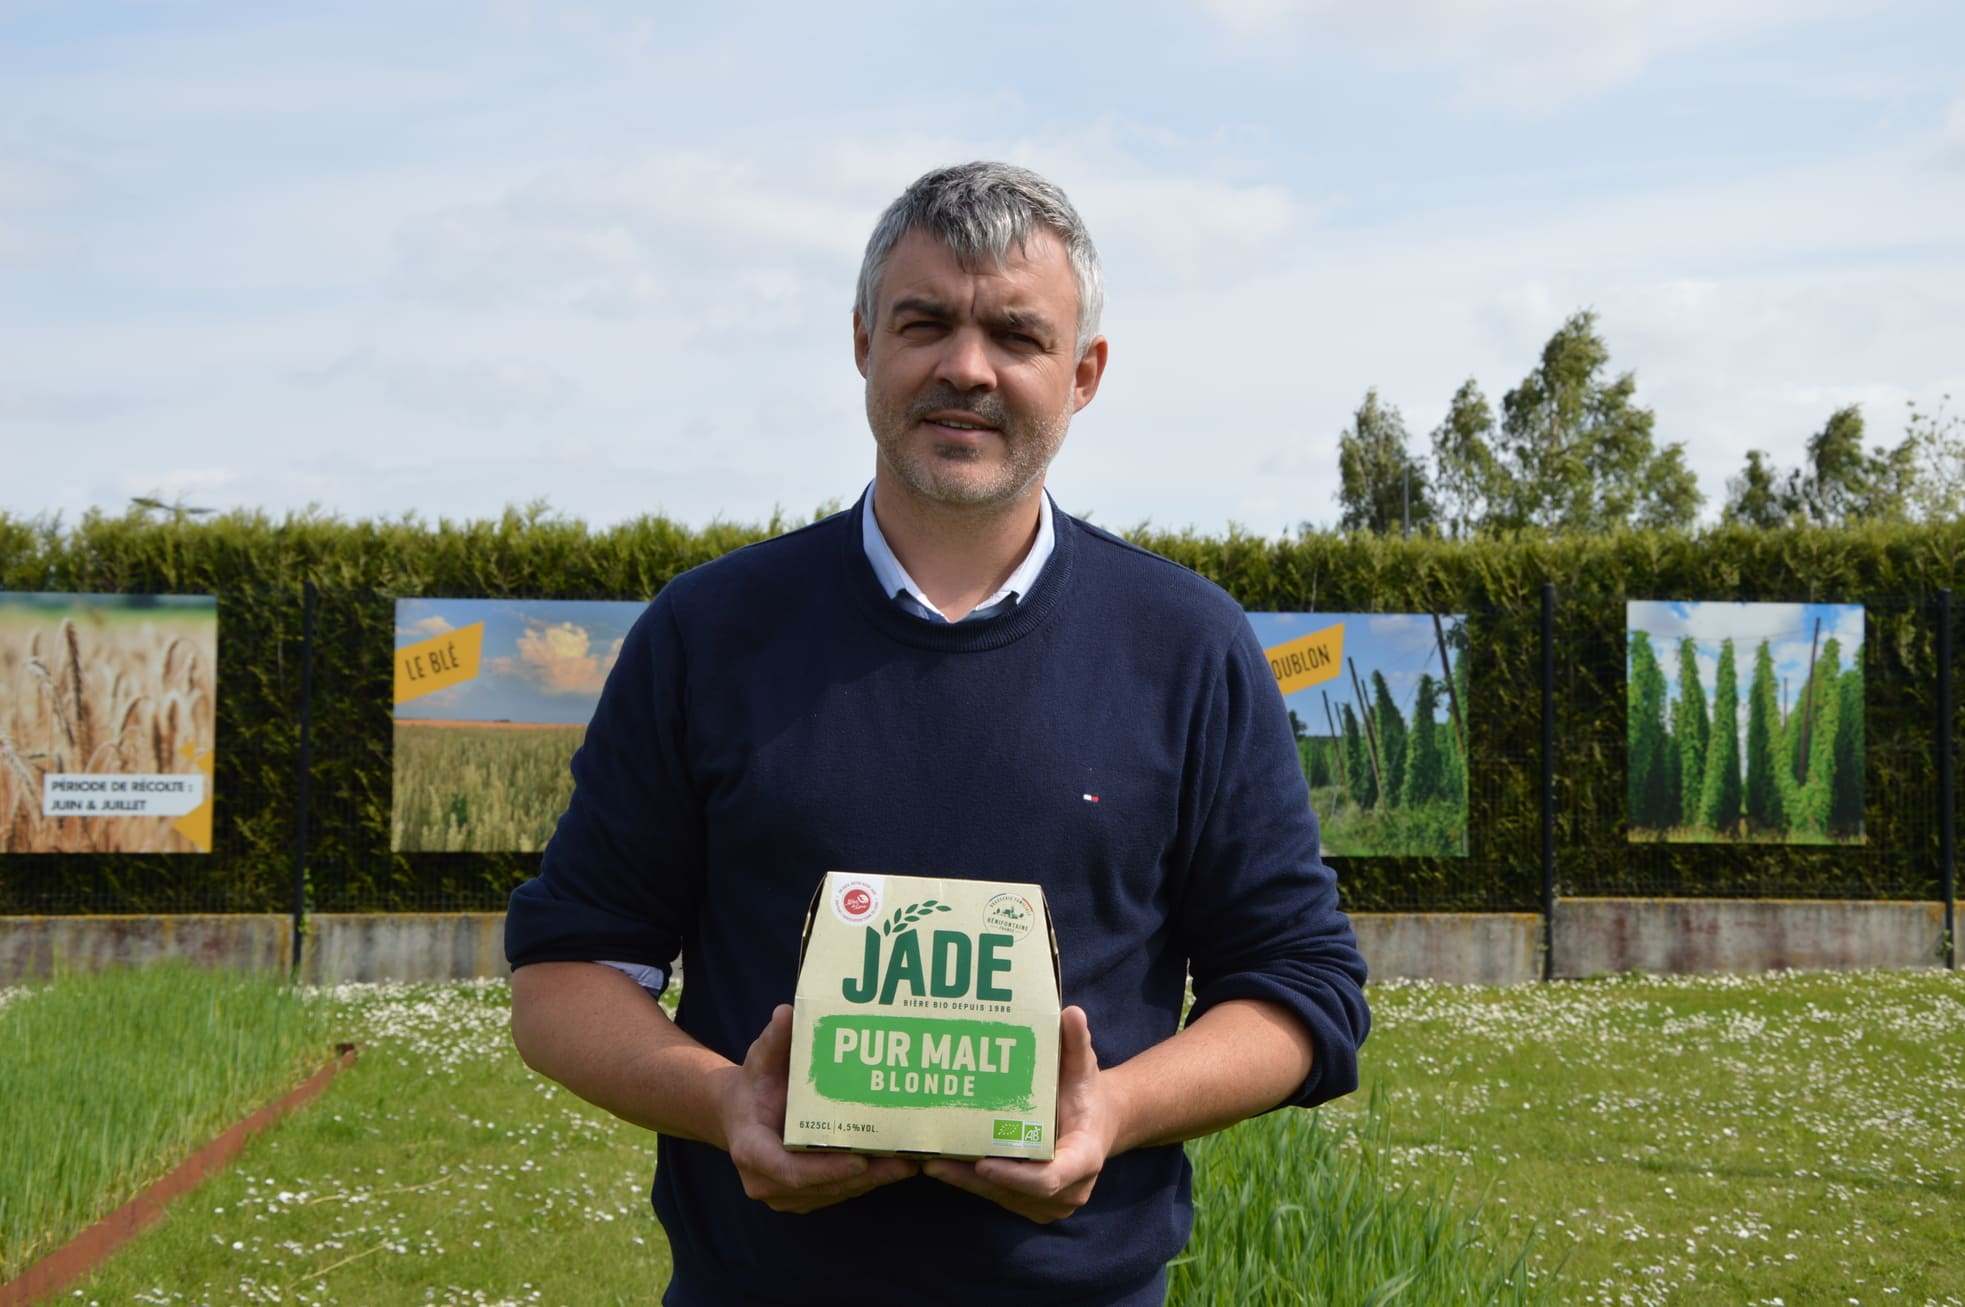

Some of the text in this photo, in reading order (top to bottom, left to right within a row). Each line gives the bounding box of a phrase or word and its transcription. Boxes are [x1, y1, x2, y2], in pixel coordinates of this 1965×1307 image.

[405, 640, 459, 680] LE BLÉ
[51, 779, 106, 792] PÉRIODE
[111, 781, 127, 792] DE
[131, 779, 184, 792] RÉCOLTE
[51, 800, 146, 810] JUIN & JUILLET
[842, 925, 1014, 1005] JADE
[903, 999, 1011, 1013] BIÈRE BIO DEPUIS 1986
[833, 1027, 1016, 1073] PUR MALT
[870, 1070, 976, 1097] BLONDE
